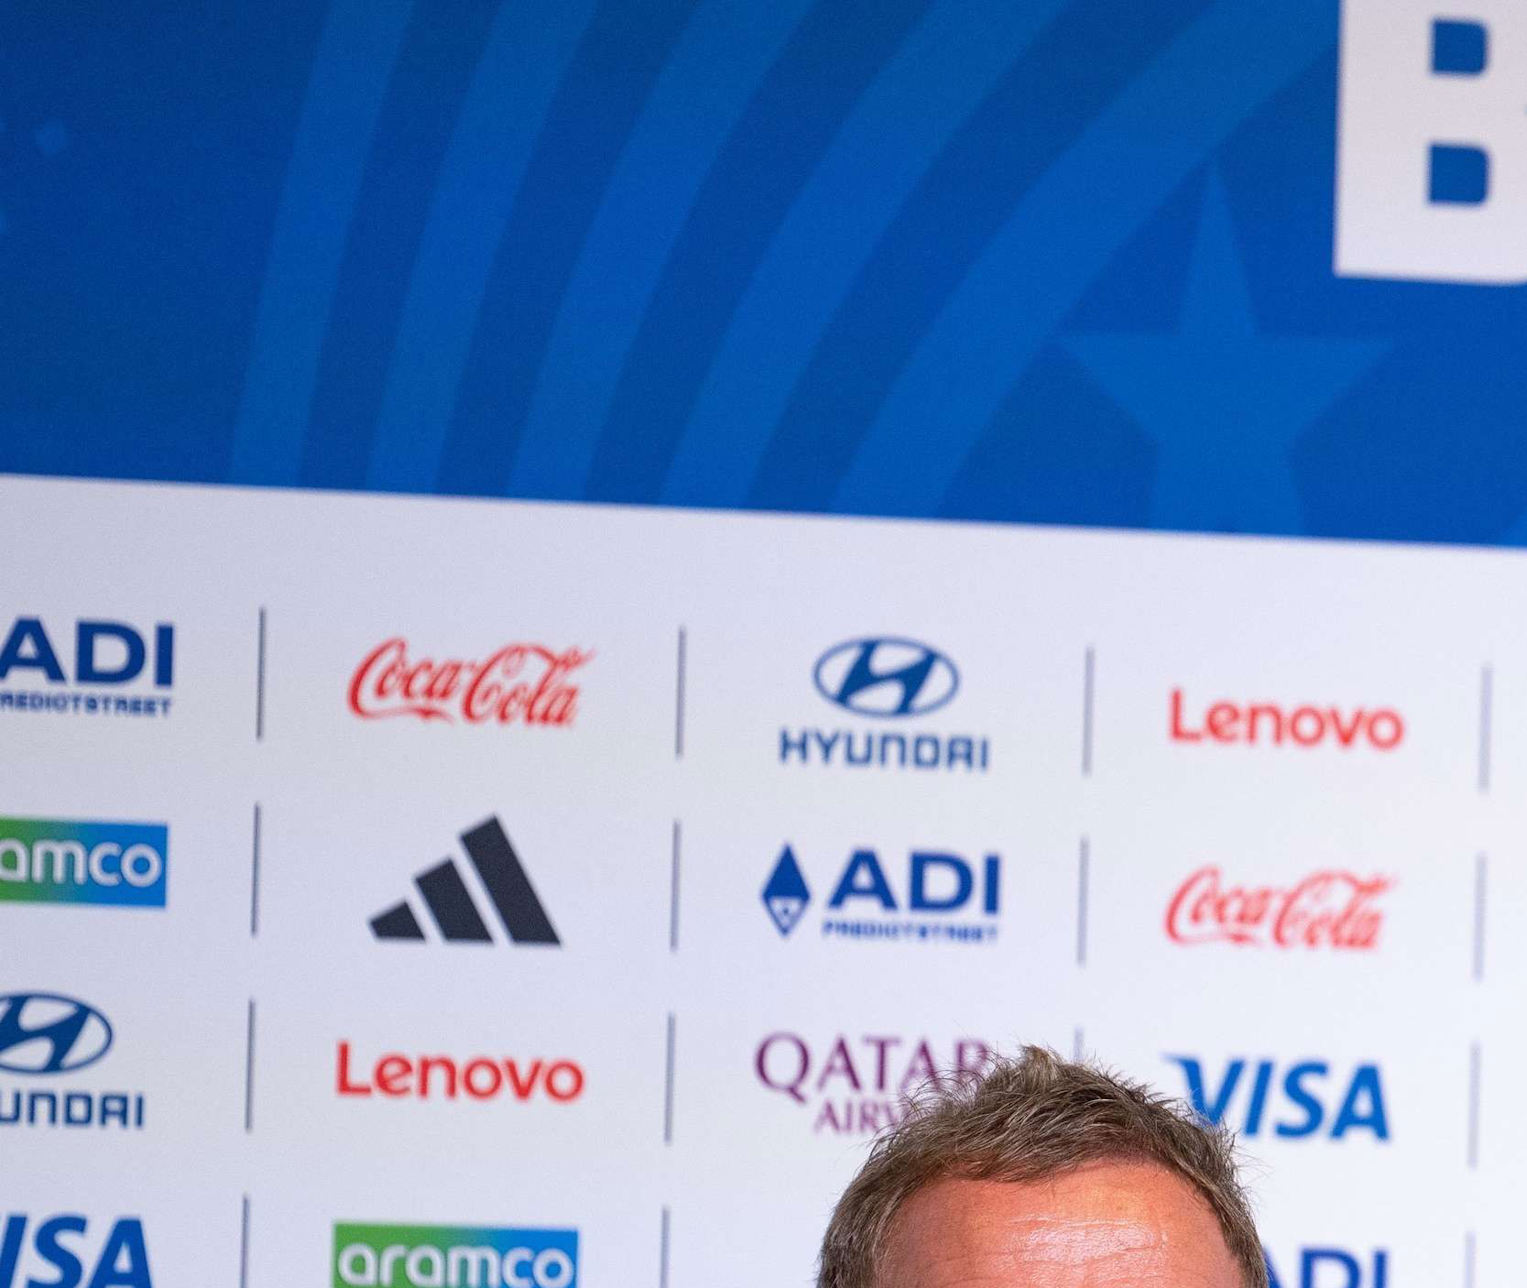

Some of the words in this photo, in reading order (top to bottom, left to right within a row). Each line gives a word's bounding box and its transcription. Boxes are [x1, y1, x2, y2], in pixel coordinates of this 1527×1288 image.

[0, 617, 175, 688] ADI
[779, 729, 989, 771] HYUNDAI
[1168, 688, 1405, 751] Lenovo
[827, 849, 1001, 916] ADI
[336, 1041, 585, 1103] Lenovo
[1160, 1050, 1392, 1142] VISA
